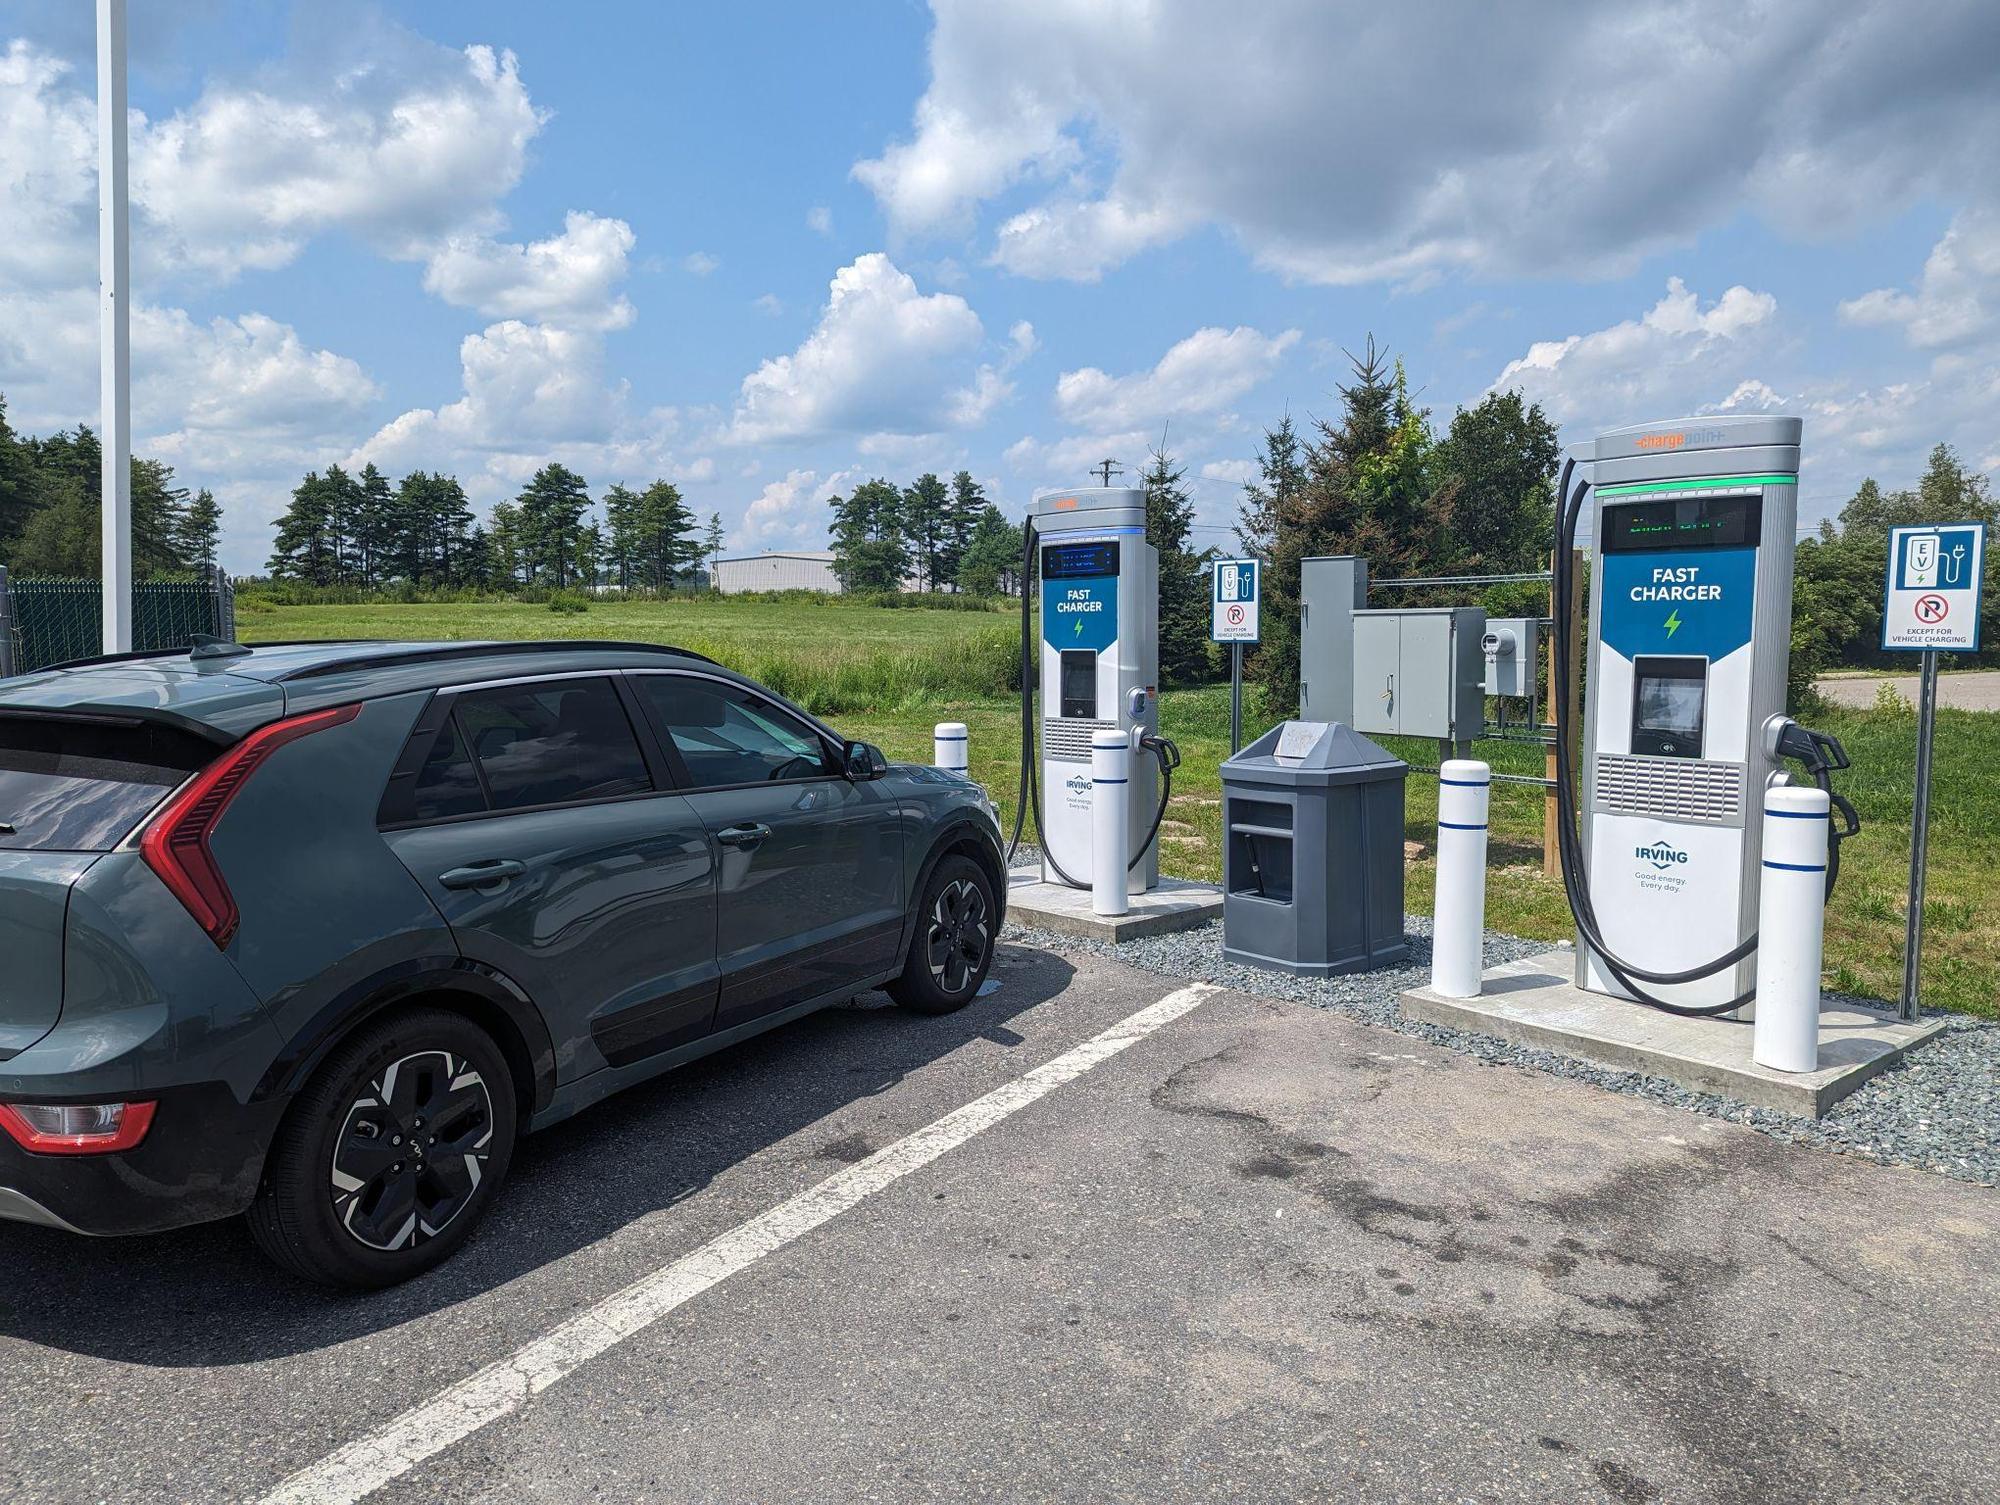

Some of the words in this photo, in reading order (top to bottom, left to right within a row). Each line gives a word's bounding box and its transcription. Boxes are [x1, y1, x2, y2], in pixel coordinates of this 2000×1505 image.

[1653, 567, 1699, 583] FAST
[1067, 589, 1091, 600] FAST
[1630, 584, 1721, 602] CHARGER
[1057, 601, 1102, 613] CHARGER
[1892, 635, 1923, 643] VEHICLE
[1924, 635, 1967, 644] CHARGING
[1066, 780, 1093, 791] IRVING
[1635, 846, 1688, 864] IRVING
[1635, 872, 1657, 880] Good
[1658, 875, 1687, 885] energy.
[1640, 880, 1662, 891] Every
[1664, 884, 1681, 894] day.
